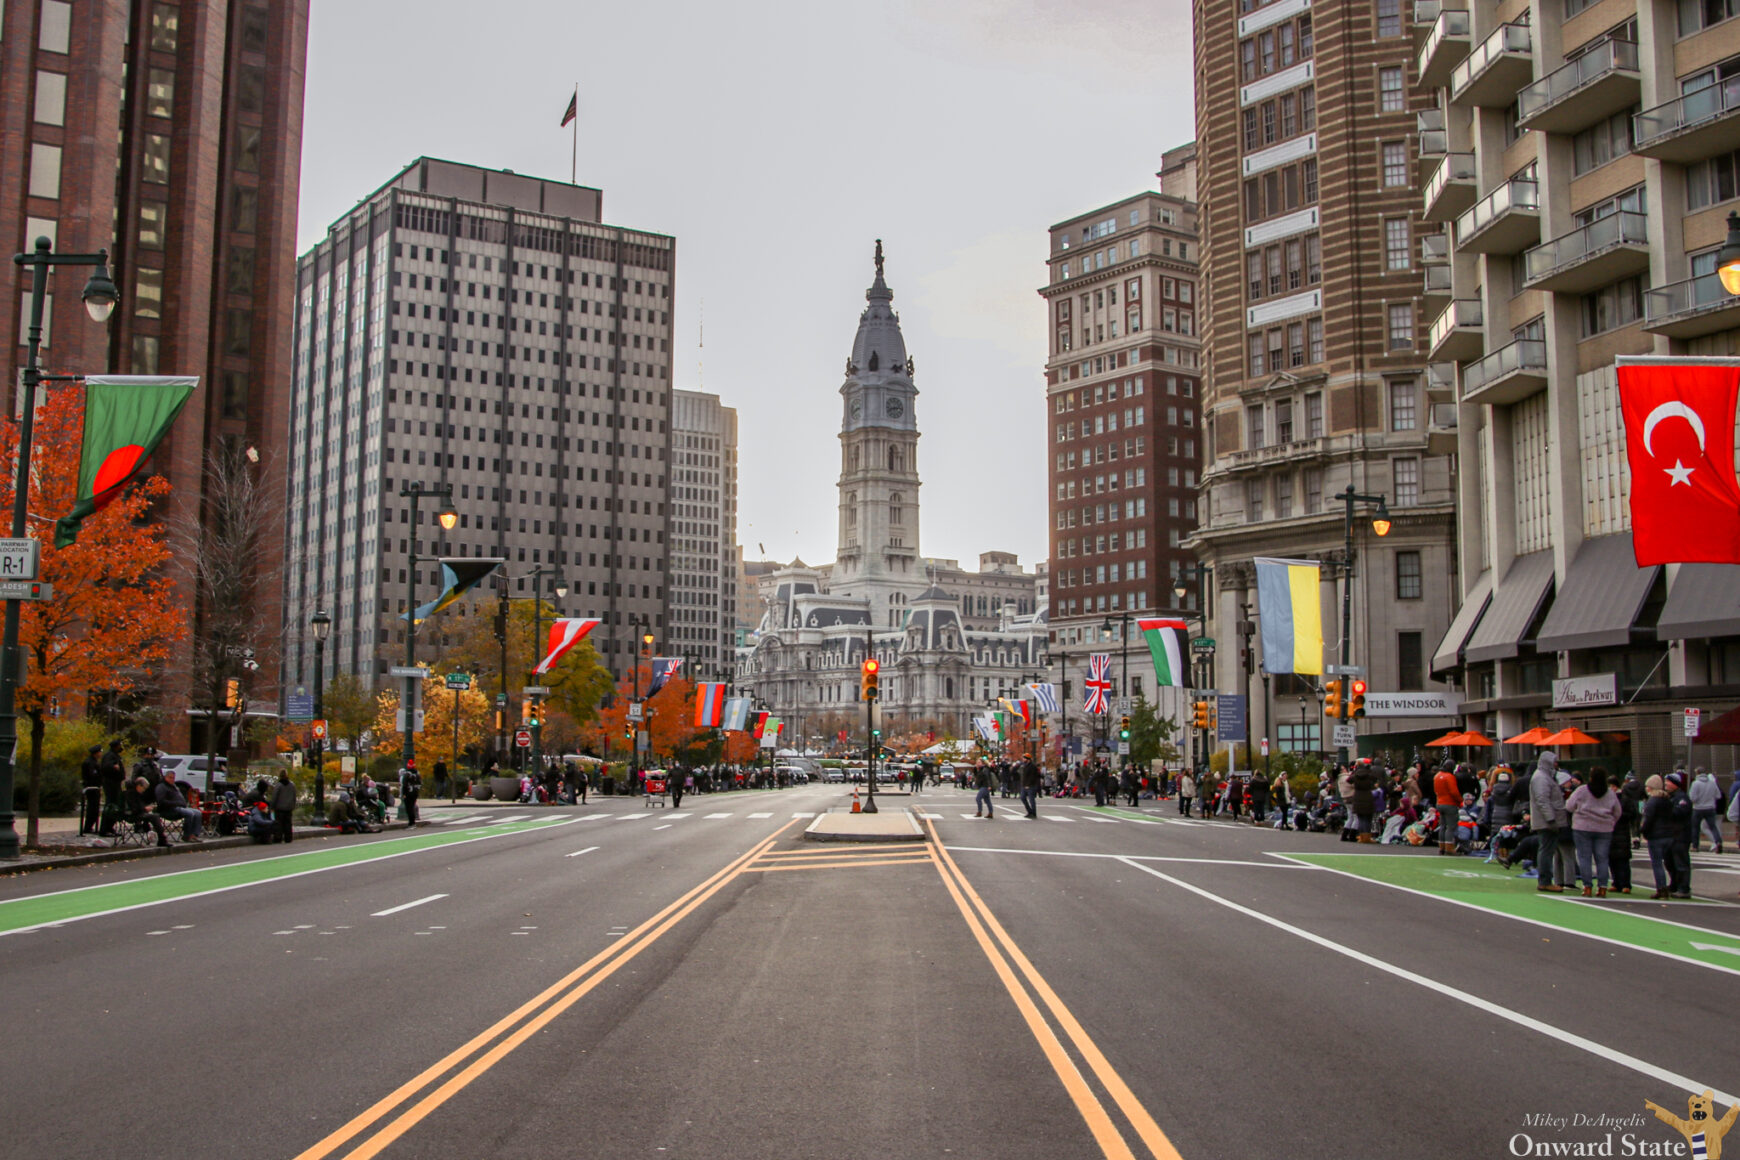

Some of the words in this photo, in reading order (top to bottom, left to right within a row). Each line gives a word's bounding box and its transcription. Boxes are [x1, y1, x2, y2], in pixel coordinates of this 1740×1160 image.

[3, 556, 24, 574] R-1
[1585, 689, 1614, 702] Parkway
[1368, 701, 1390, 709] THE
[1393, 699, 1446, 709] WINDSOR
